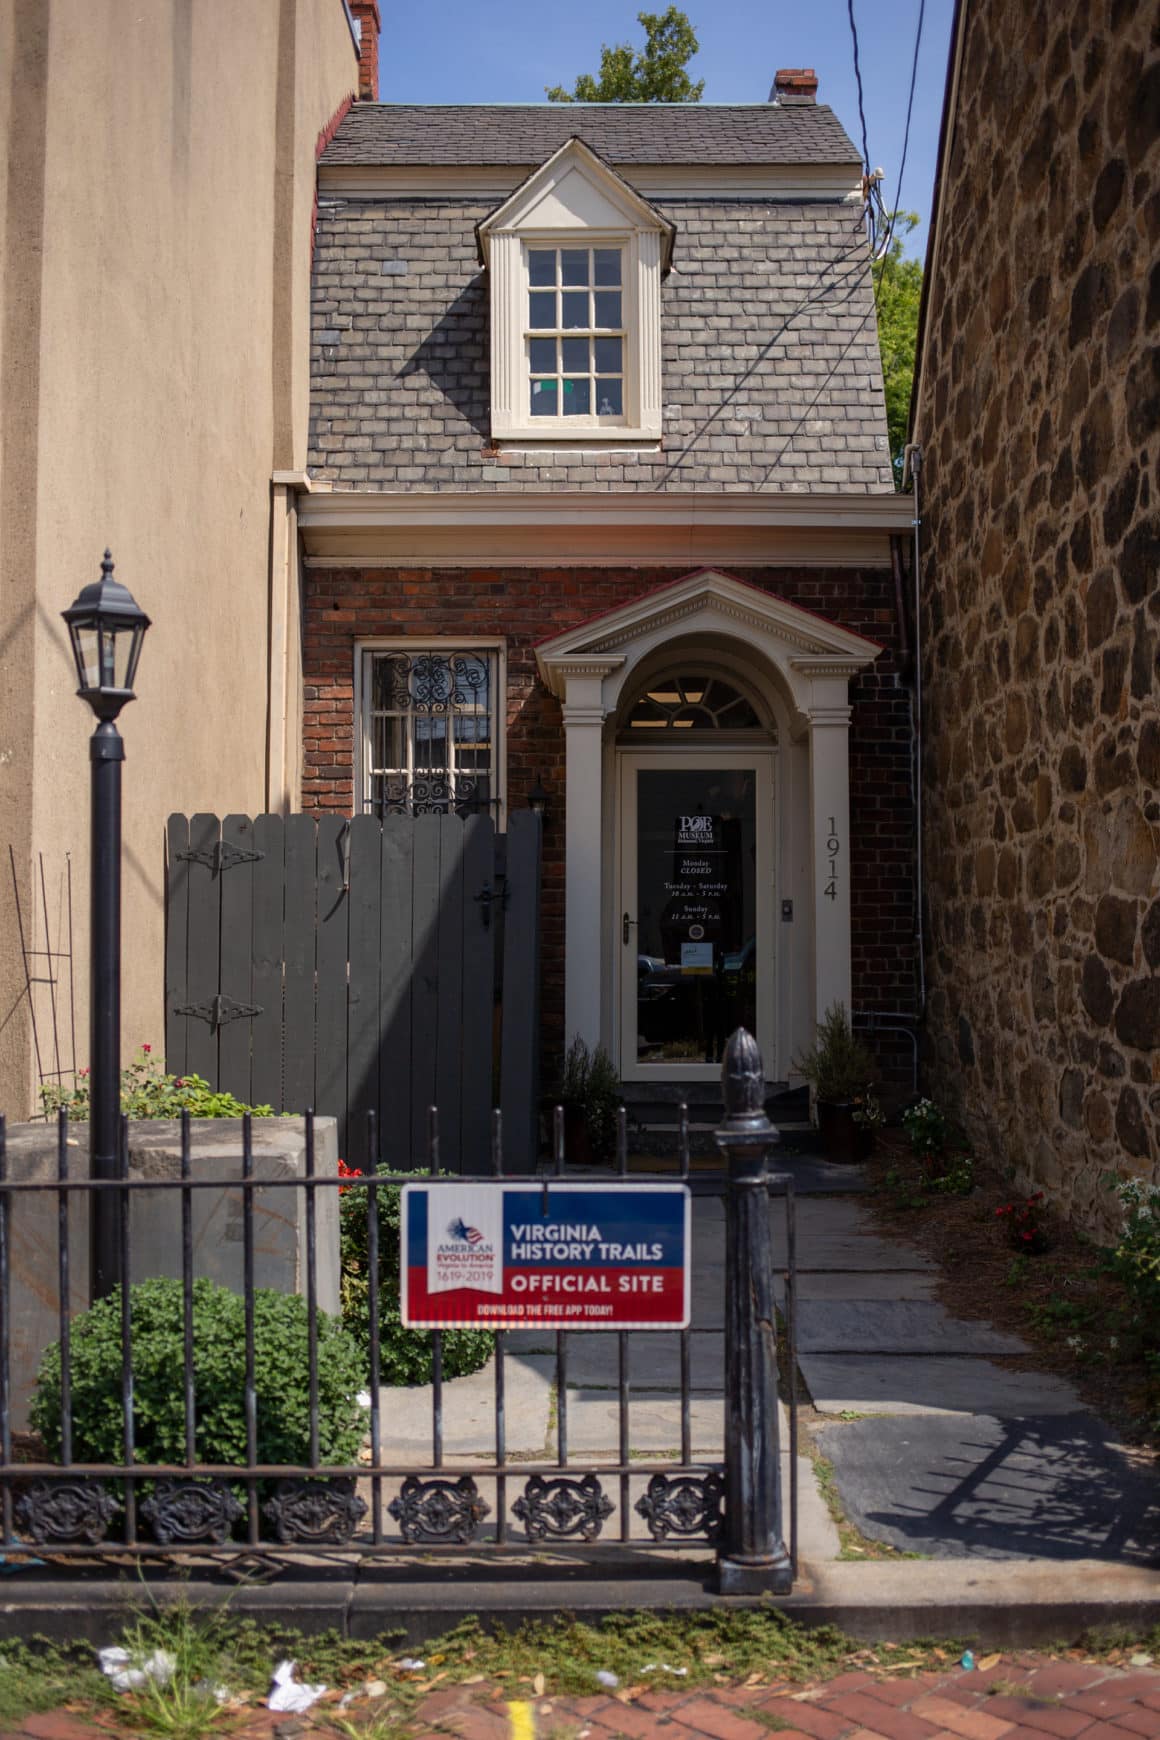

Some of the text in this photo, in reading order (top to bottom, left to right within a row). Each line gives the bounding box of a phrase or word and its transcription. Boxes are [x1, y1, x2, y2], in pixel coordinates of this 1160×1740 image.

[679, 816, 713, 831] POE
[679, 832, 713, 840] MUSEUM
[682, 859, 709, 867] Monday
[823, 816, 840, 901] 1914
[664, 882, 690, 890] Tuesday
[698, 882, 728, 891] Saturday
[683, 904, 708, 913] Sunday
[511, 1224, 602, 1242] VIRGINIA
[437, 1244, 493, 1253] AMERICAN
[511, 1243, 663, 1260] HISTORY TRAILS
[437, 1253, 493, 1262] EVOLUTION
[437, 1271, 494, 1281] 1619-2019
[510, 1275, 664, 1293] OFFICIAL SITE
[477, 1304, 613, 1316] DOWNLOAD THE FREE APP TODAY!
